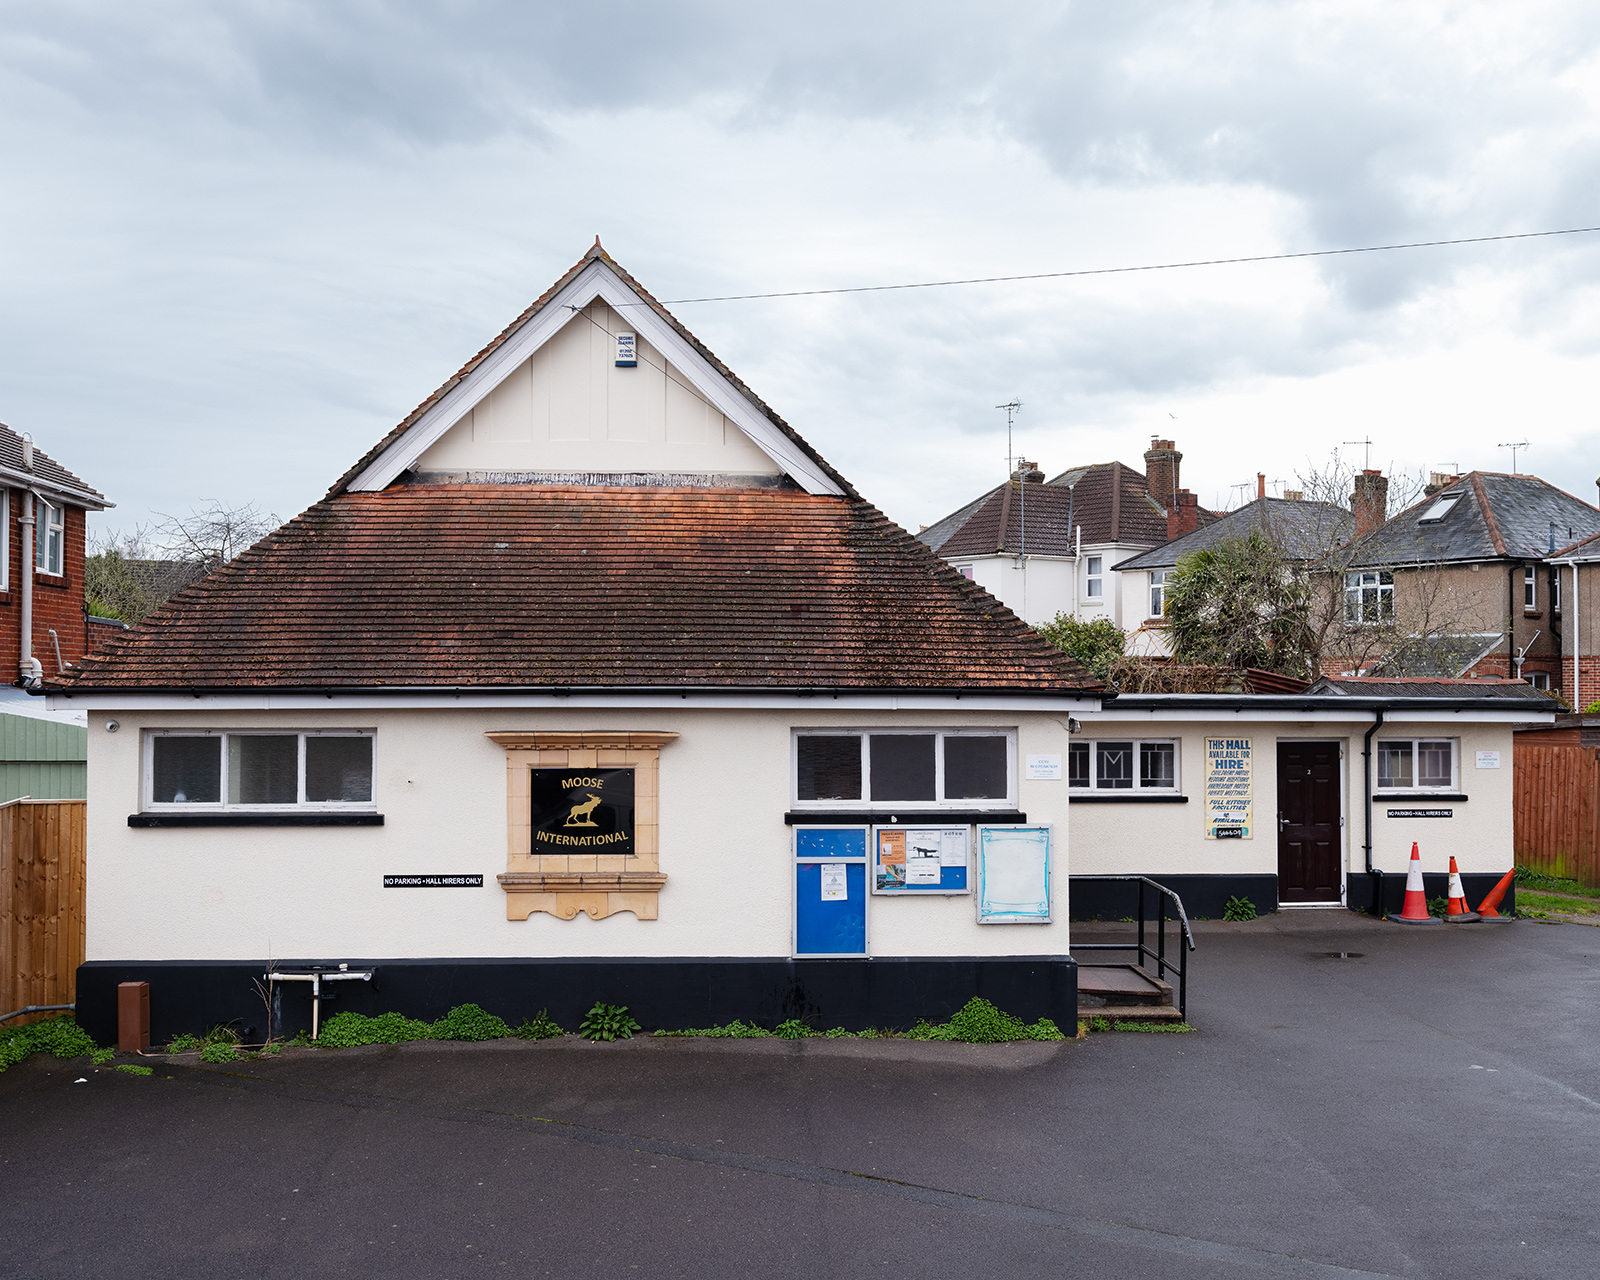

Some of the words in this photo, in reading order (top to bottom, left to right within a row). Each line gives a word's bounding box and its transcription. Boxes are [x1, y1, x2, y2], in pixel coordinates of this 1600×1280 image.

[1208, 740, 1224, 749] THIS
[1226, 740, 1250, 749] HALL
[1215, 760, 1244, 769] HIRE
[562, 777, 604, 789] MOOSE
[536, 831, 629, 846] INTERNATIONAL
